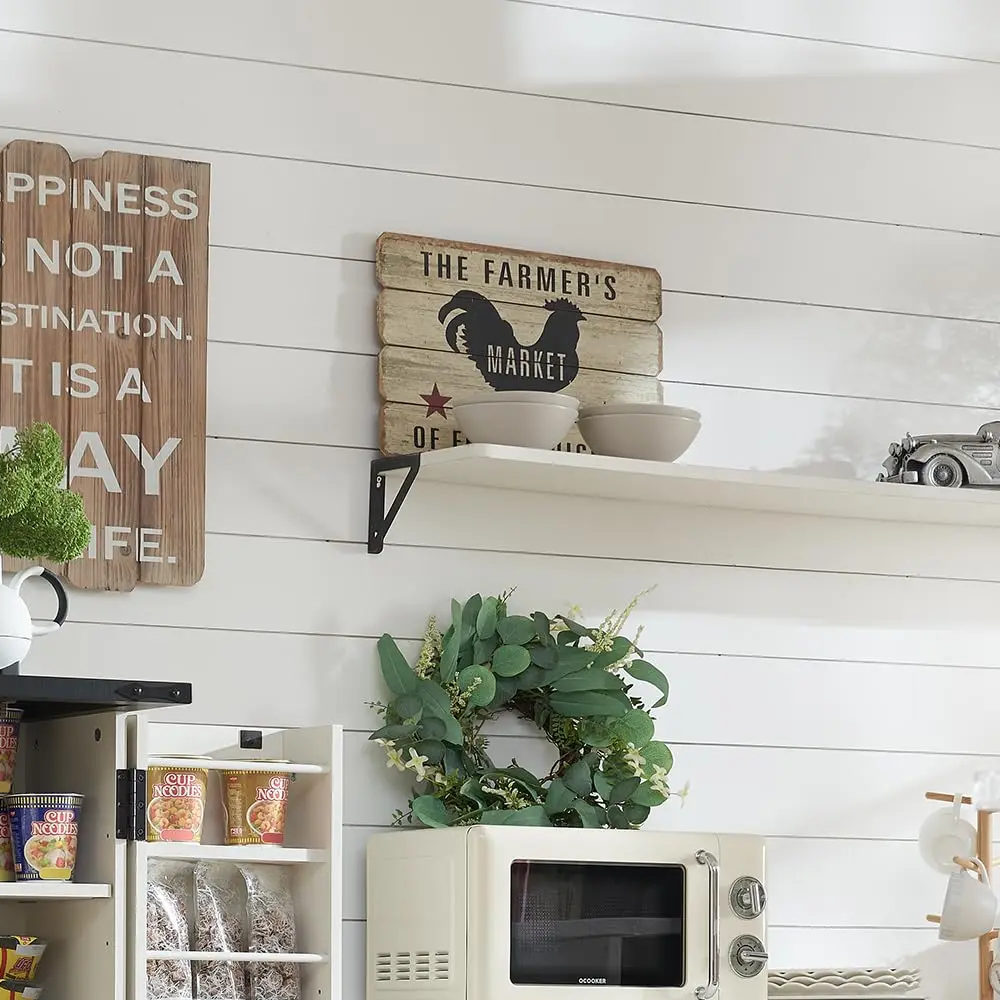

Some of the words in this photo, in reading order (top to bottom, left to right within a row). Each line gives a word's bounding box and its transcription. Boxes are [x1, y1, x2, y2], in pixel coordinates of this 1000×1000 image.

[26, 237, 133, 280] NOT
[147, 250, 184, 286] A
[420, 250, 468, 281] THE
[484, 259, 617, 301] FARMER'S
[486, 344, 567, 382] MARKET
[51, 361, 99, 400] IS
[116, 367, 152, 403] A
[413, 425, 440, 450] OF
[82, 525, 177, 565] IFE.
[153, 785, 201, 797] NOODLES
[165, 774, 196, 786] CUP
[31, 822, 79, 835] NOODLES
[44, 811, 74, 823] CUP
